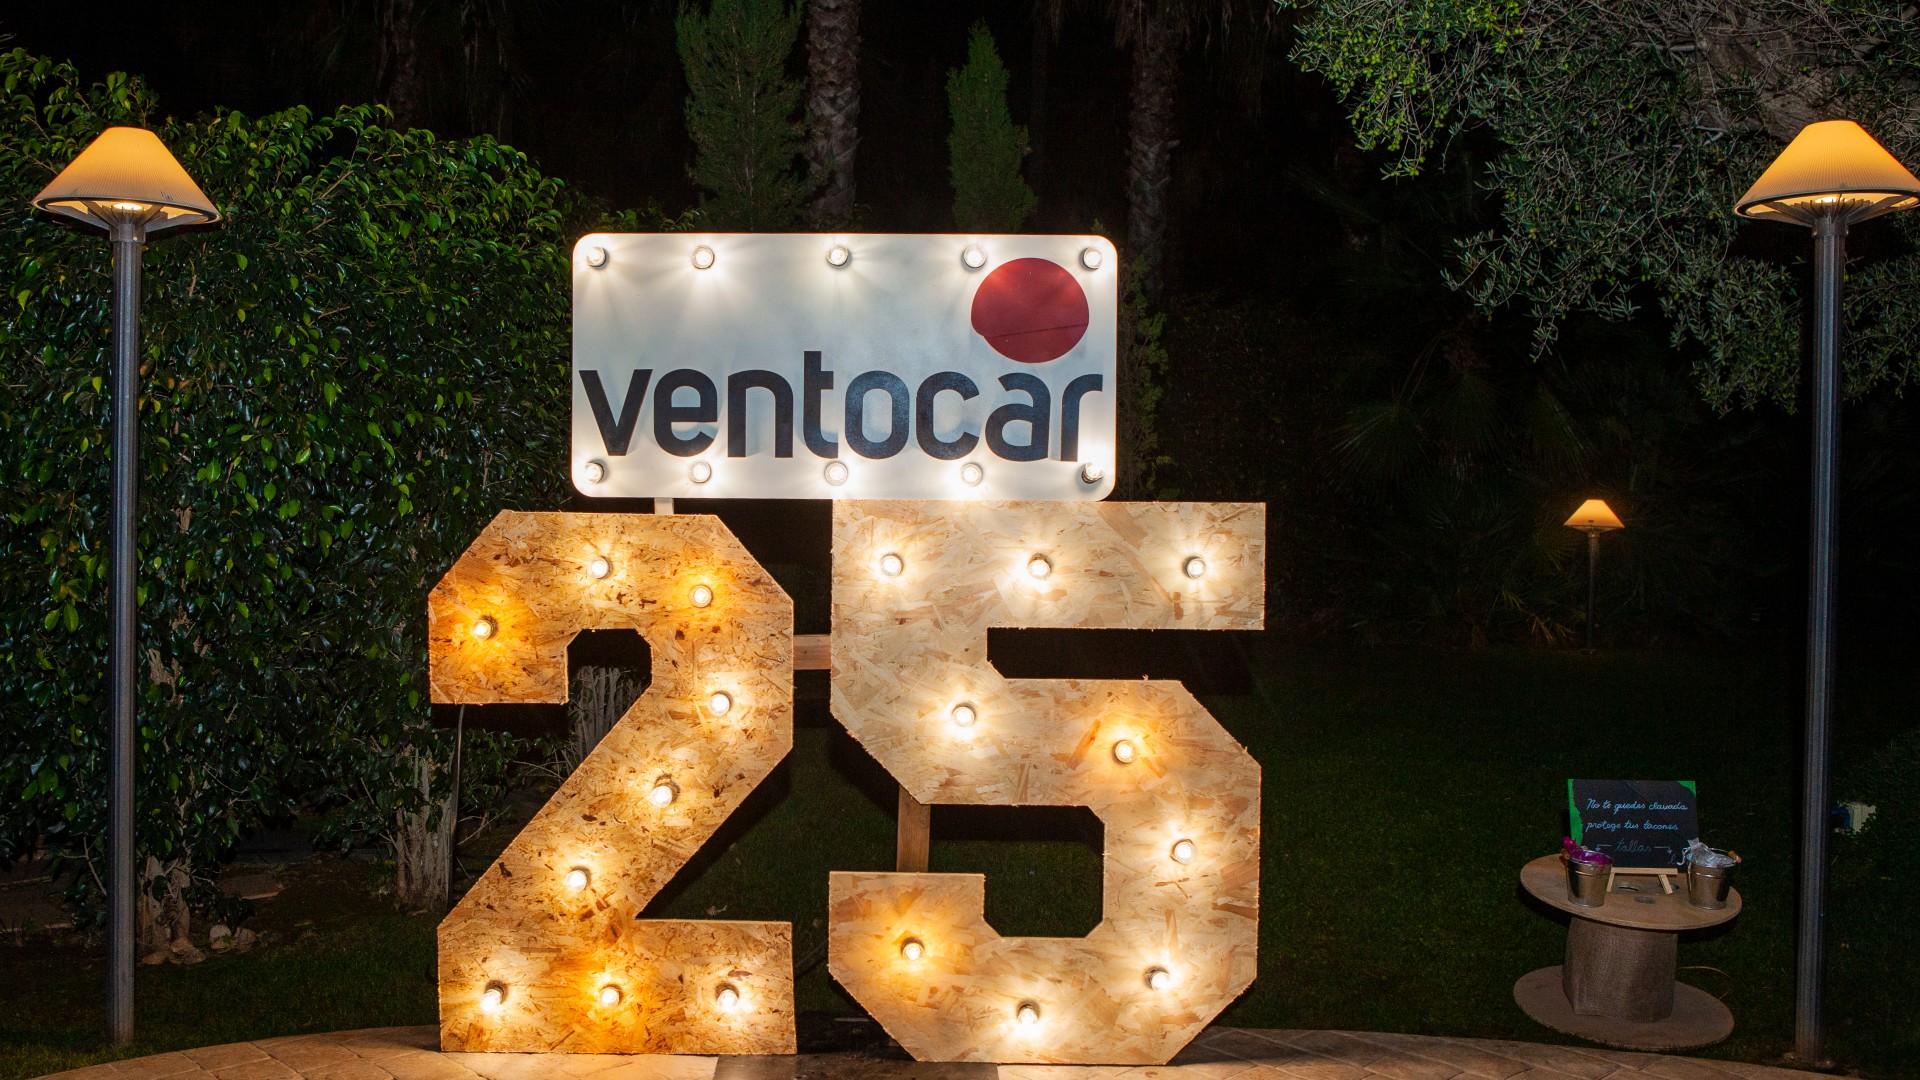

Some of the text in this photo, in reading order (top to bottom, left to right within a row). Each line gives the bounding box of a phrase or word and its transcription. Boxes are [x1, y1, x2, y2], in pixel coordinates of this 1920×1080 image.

[578, 350, 1104, 462] ventocar
[428, 500, 1267, 1066] 25
[1587, 798, 1600, 811] No
[1602, 800, 1611, 810] te
[1585, 819, 1679, 833] protege tus tacones
[1615, 838, 1652, 853] tallas
